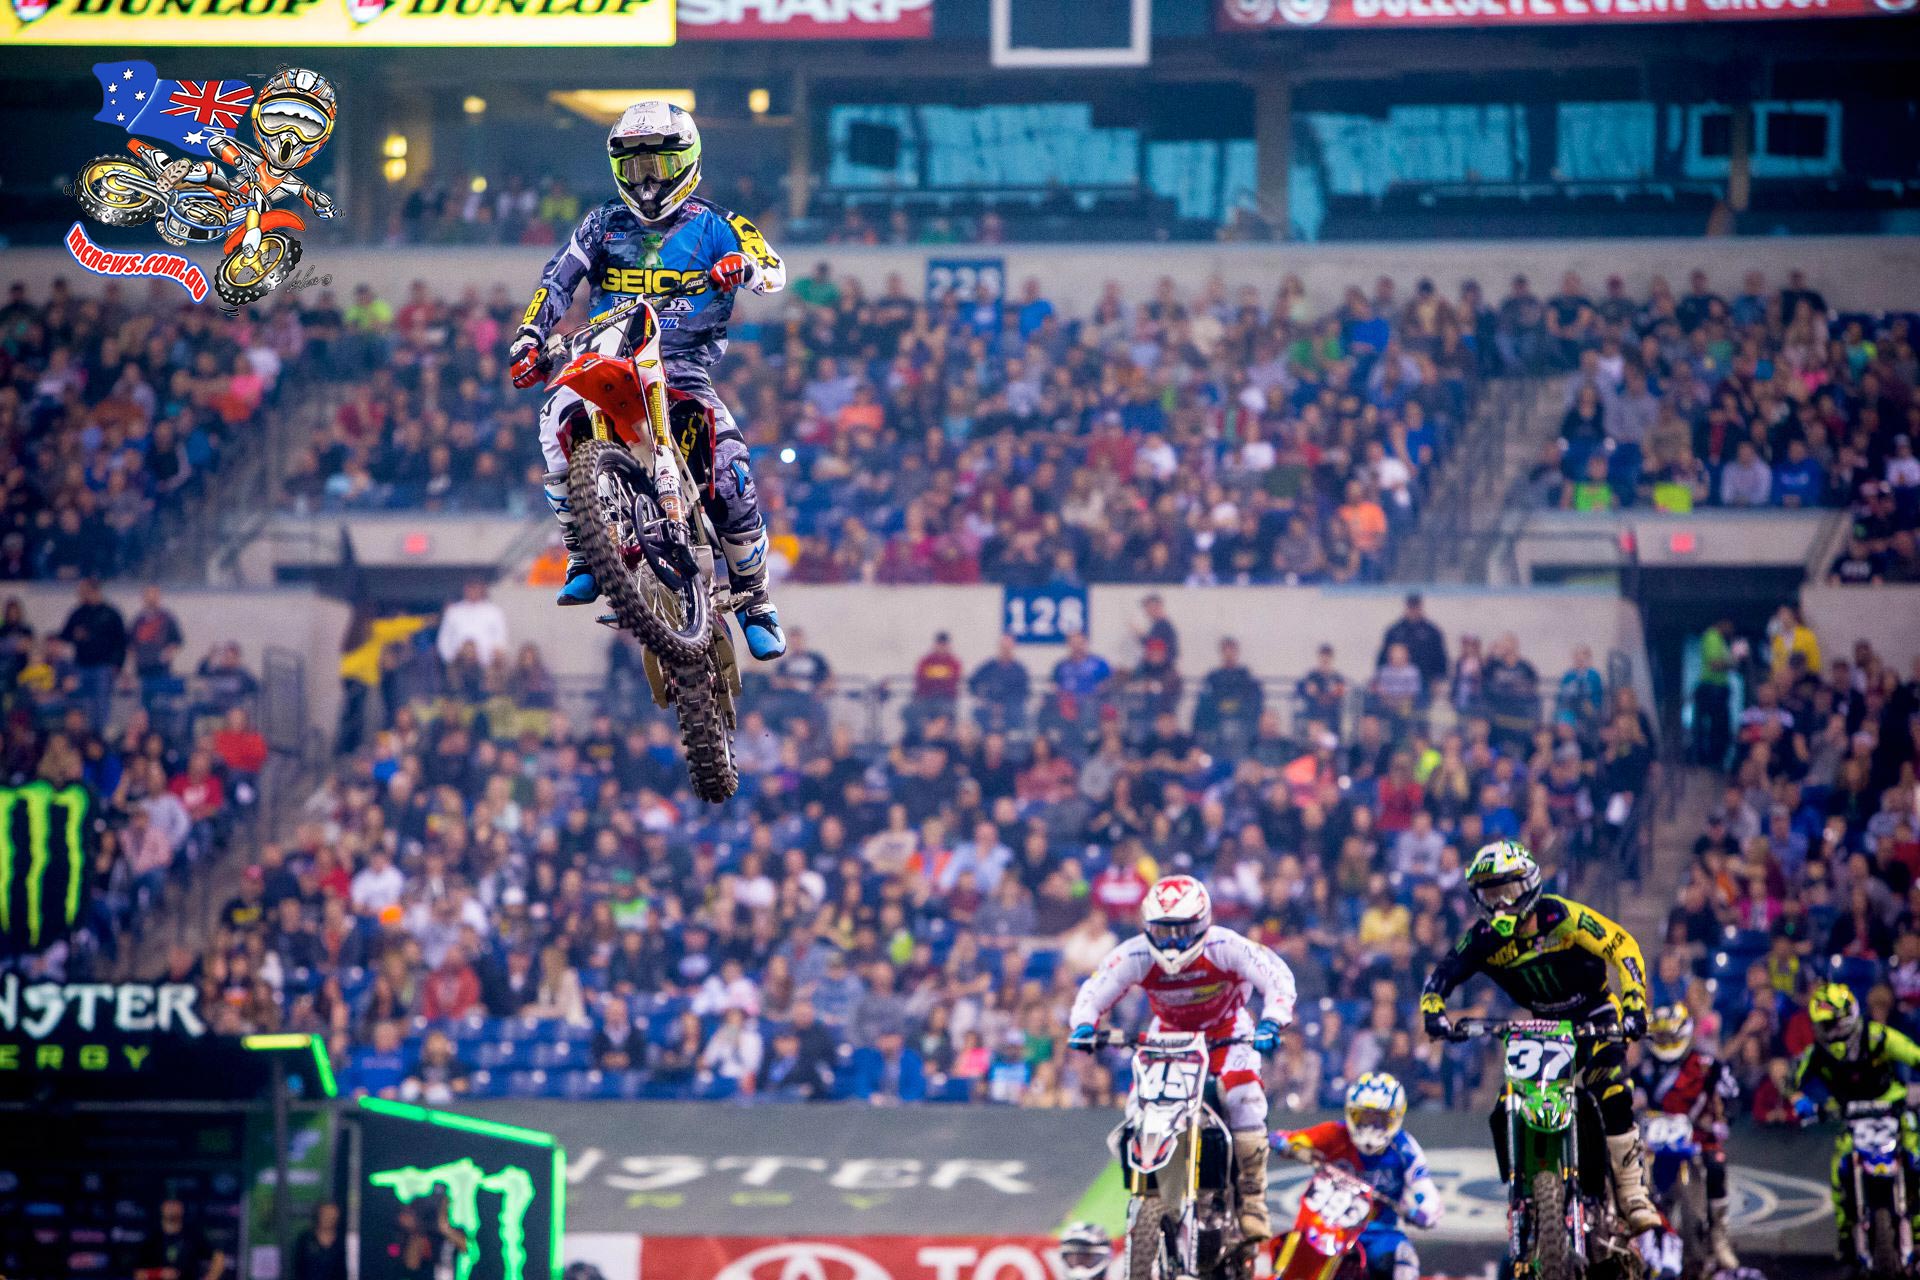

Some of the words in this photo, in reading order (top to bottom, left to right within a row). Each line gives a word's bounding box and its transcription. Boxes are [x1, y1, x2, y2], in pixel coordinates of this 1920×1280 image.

[601, 267, 707, 295] GEICO
[612, 295, 695, 312] HDA
[1008, 596, 1084, 636] 128
[1505, 1039, 1577, 1081] 37
